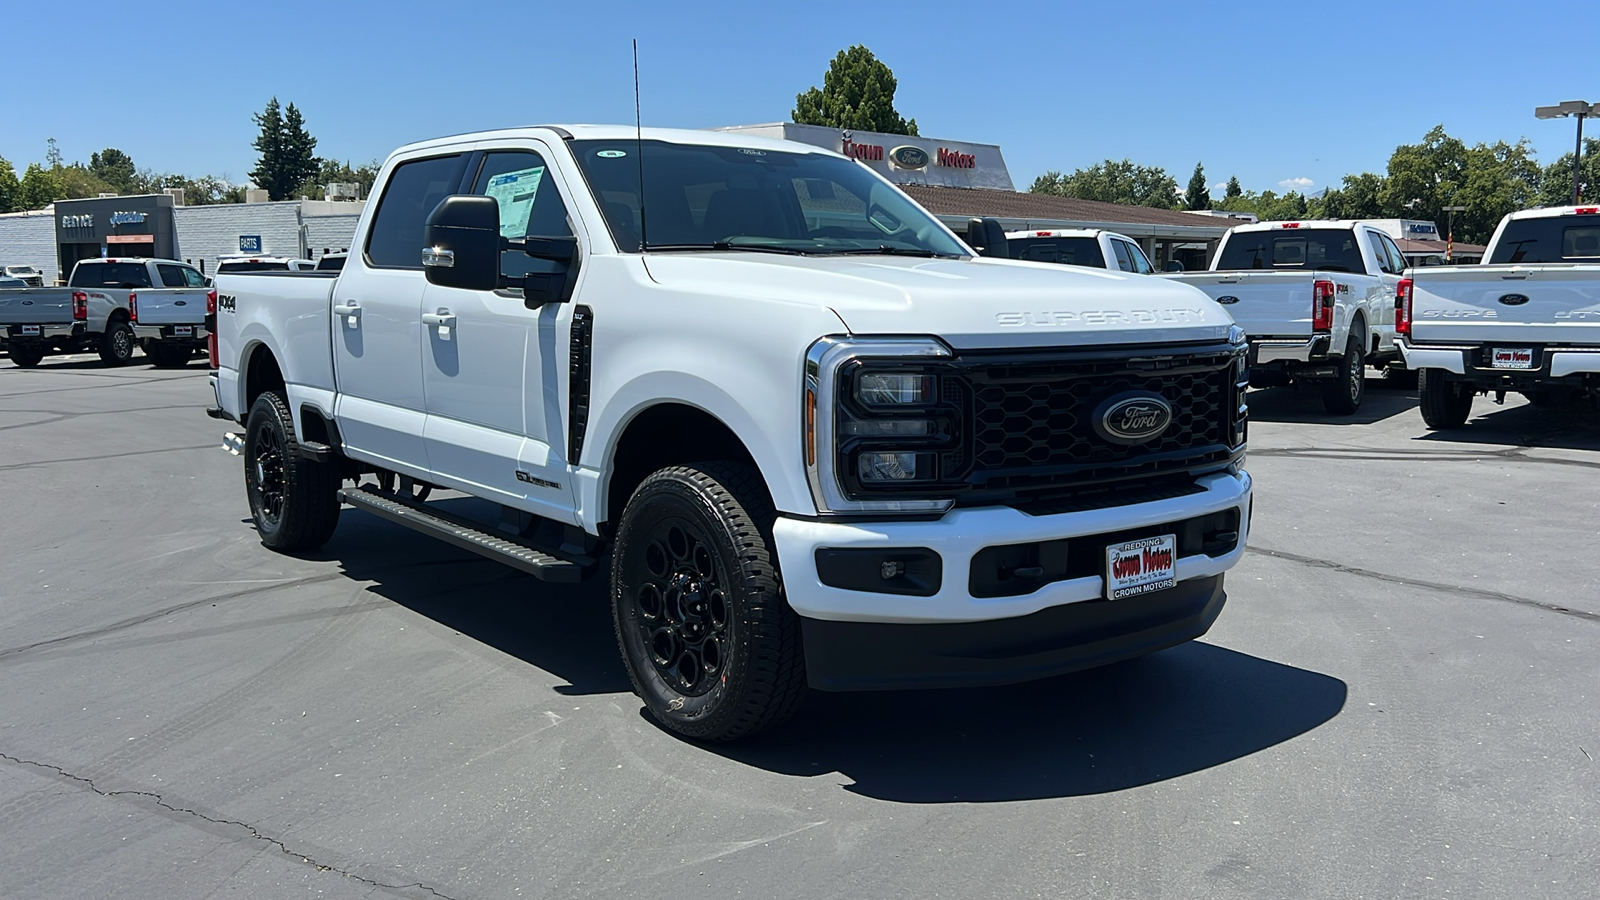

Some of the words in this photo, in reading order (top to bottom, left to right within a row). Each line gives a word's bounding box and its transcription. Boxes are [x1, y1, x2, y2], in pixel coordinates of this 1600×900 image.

[843, 139, 884, 161] Crown
[937, 147, 975, 168] Motors
[240, 237, 258, 249] PARTS
[218, 294, 236, 311] FX4
[995, 311, 1131, 327] SUPER
[1131, 308, 1206, 324] DUTY
[1121, 406, 1160, 429] Ford
[1124, 538, 1160, 551] REDDING
[1112, 552, 1140, 579] Crown
[1142, 546, 1172, 574] Motors
[1114, 586, 1142, 598] CROWN
[1143, 579, 1173, 592] MOTORS
